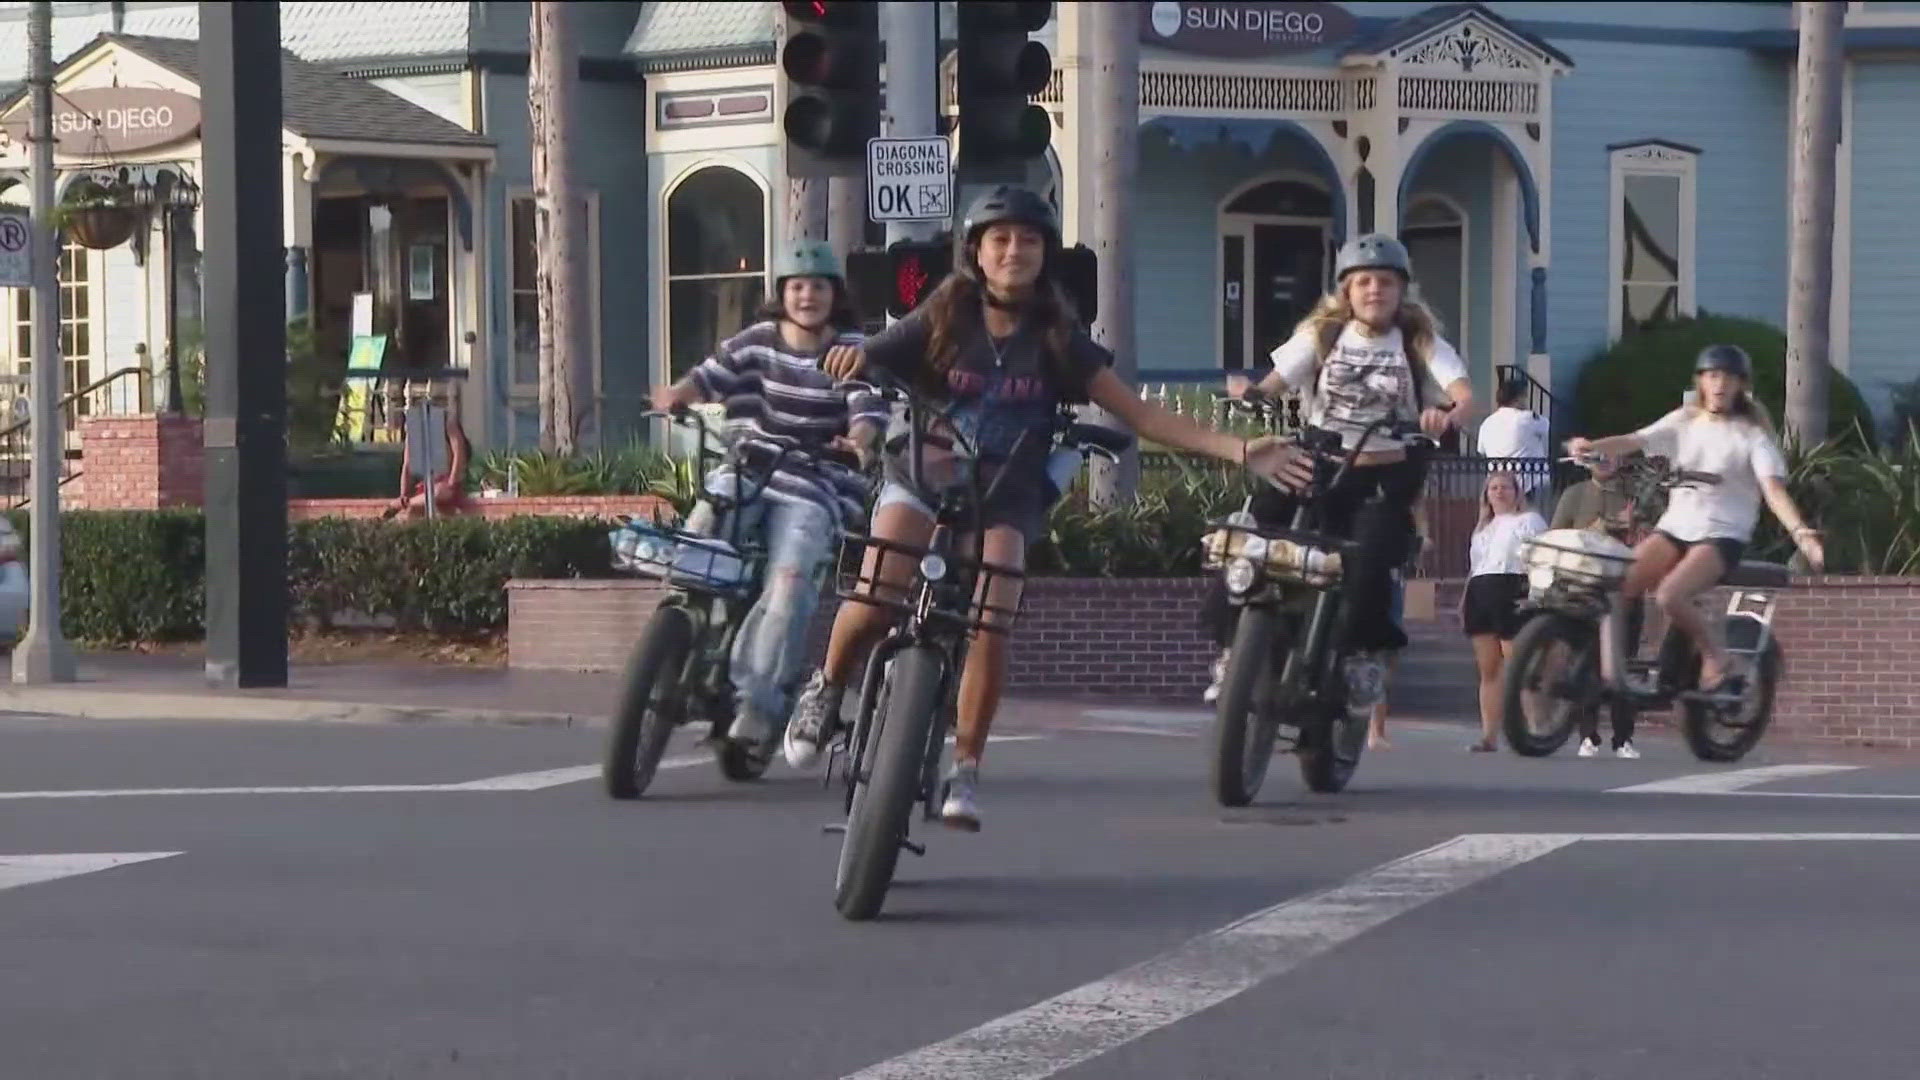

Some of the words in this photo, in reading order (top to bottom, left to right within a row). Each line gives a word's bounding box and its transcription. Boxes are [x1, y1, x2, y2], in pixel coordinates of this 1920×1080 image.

[1186, 7, 1239, 30] SUN
[1245, 10, 1323, 42] DIEGO
[59, 110, 101, 133] SUN
[107, 106, 173, 138] DIEGO
[876, 144, 944, 160] DIAGONAL
[877, 161, 944, 176] CROSSING
[878, 185, 913, 216] OK
